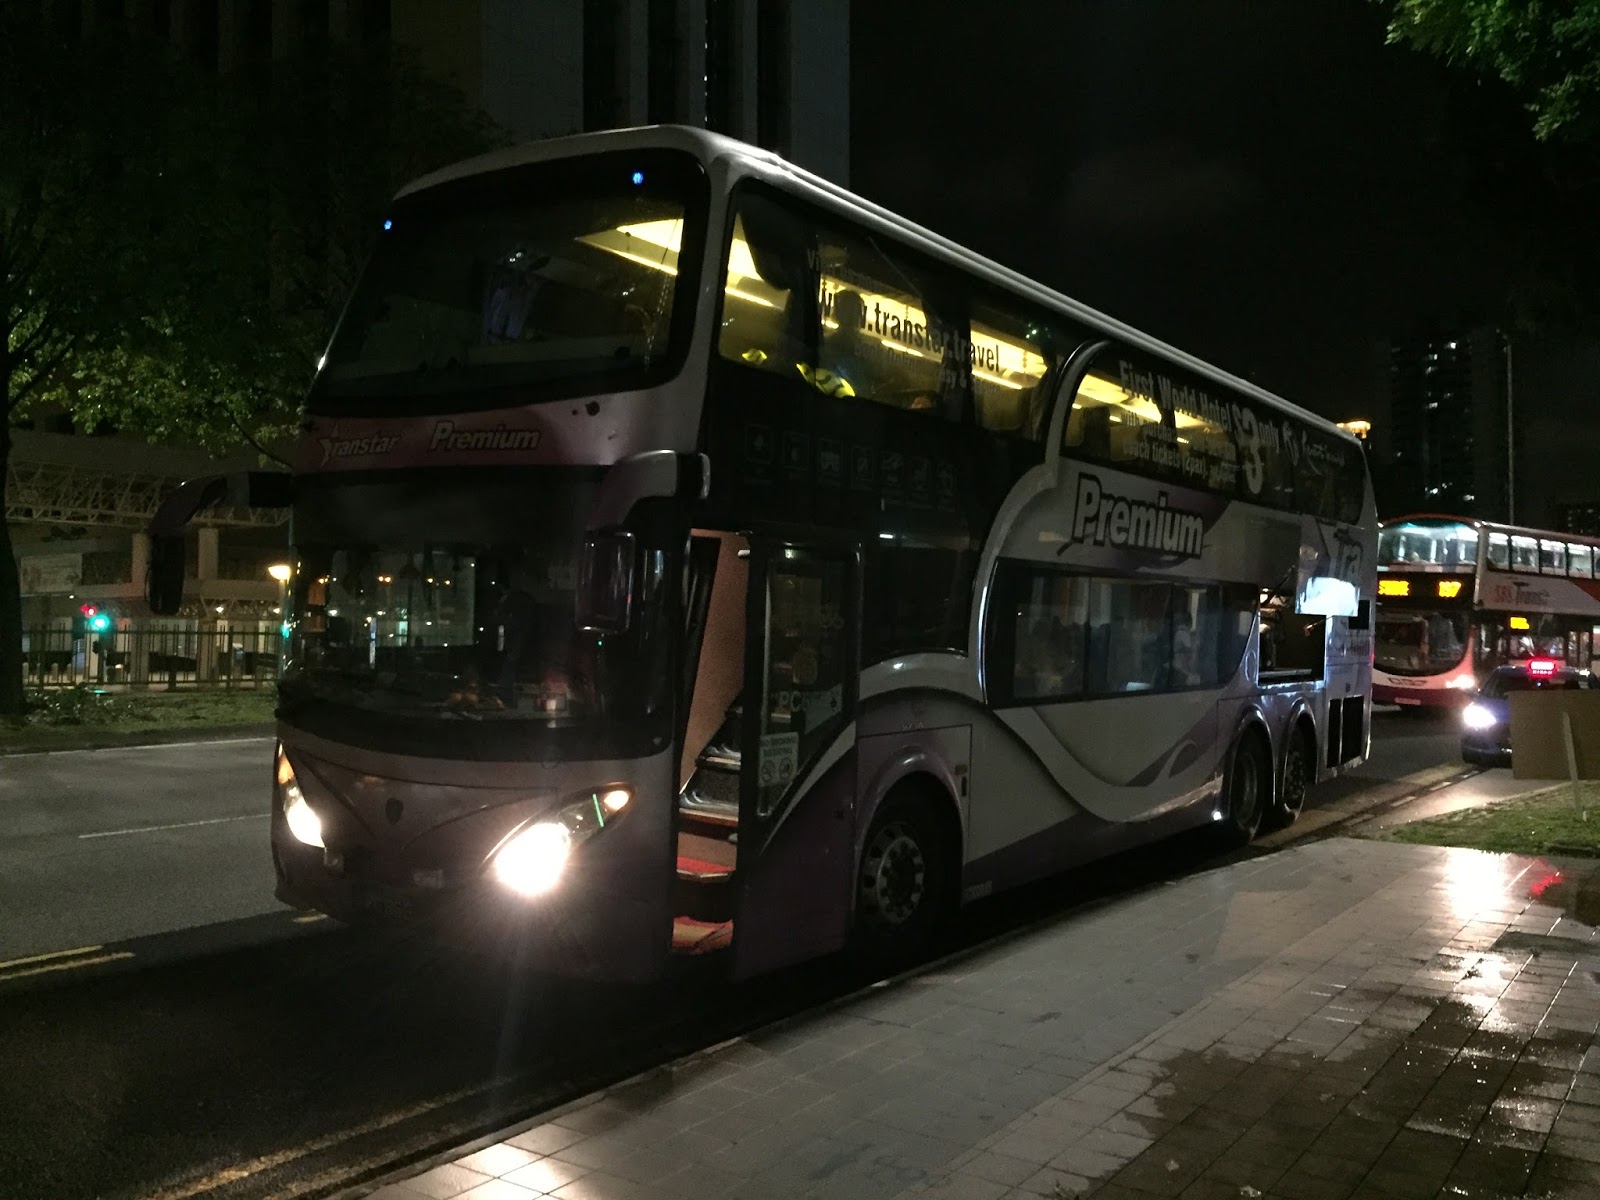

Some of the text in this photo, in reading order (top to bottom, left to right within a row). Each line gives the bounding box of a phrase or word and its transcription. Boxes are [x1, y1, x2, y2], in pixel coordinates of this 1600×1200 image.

[820, 285, 1000, 373] w.transtar.travel
[1119, 360, 1154, 402] First
[430, 420, 543, 450] Premium
[1070, 472, 1204, 558] Premium
